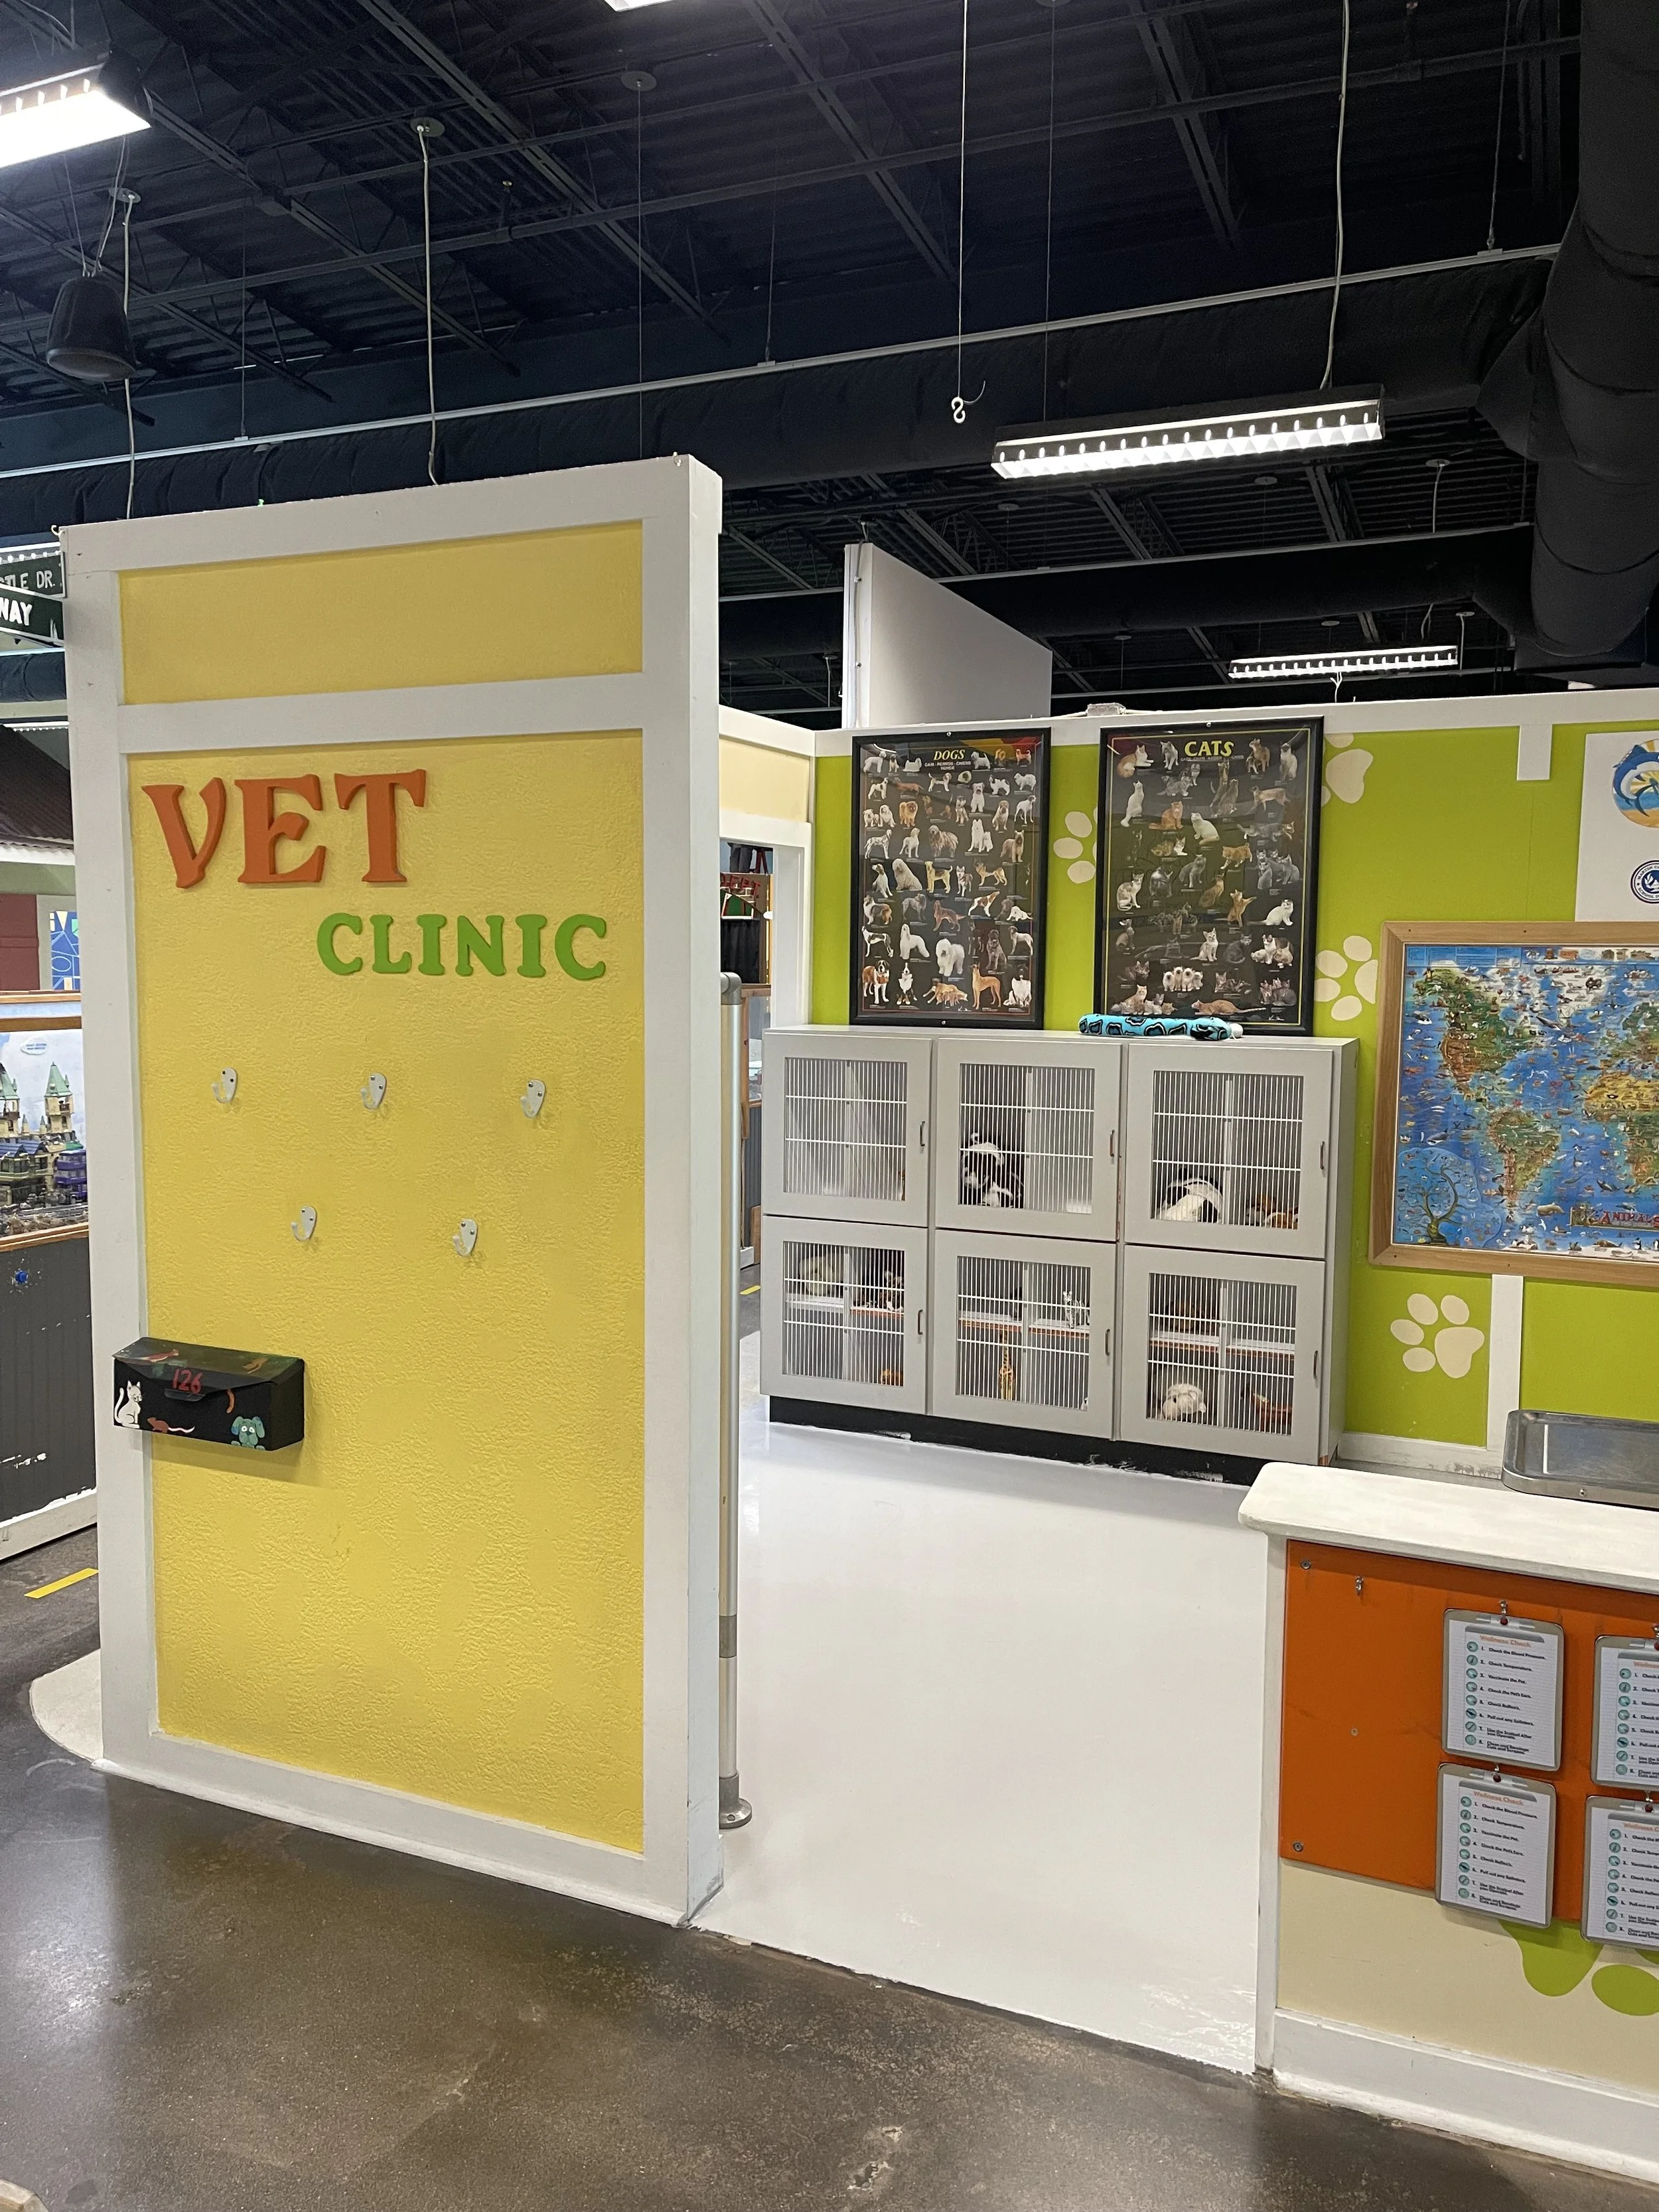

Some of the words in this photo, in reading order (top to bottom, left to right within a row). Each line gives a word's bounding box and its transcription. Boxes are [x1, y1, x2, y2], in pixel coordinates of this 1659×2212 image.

[36, 570, 56, 589] DR.
[933, 749, 966, 761] DOGS
[1185, 741, 1234, 757] CATS
[141, 769, 427, 888] VET
[317, 912, 607, 981] CLINIC
[172, 1368, 203, 1394] 126
